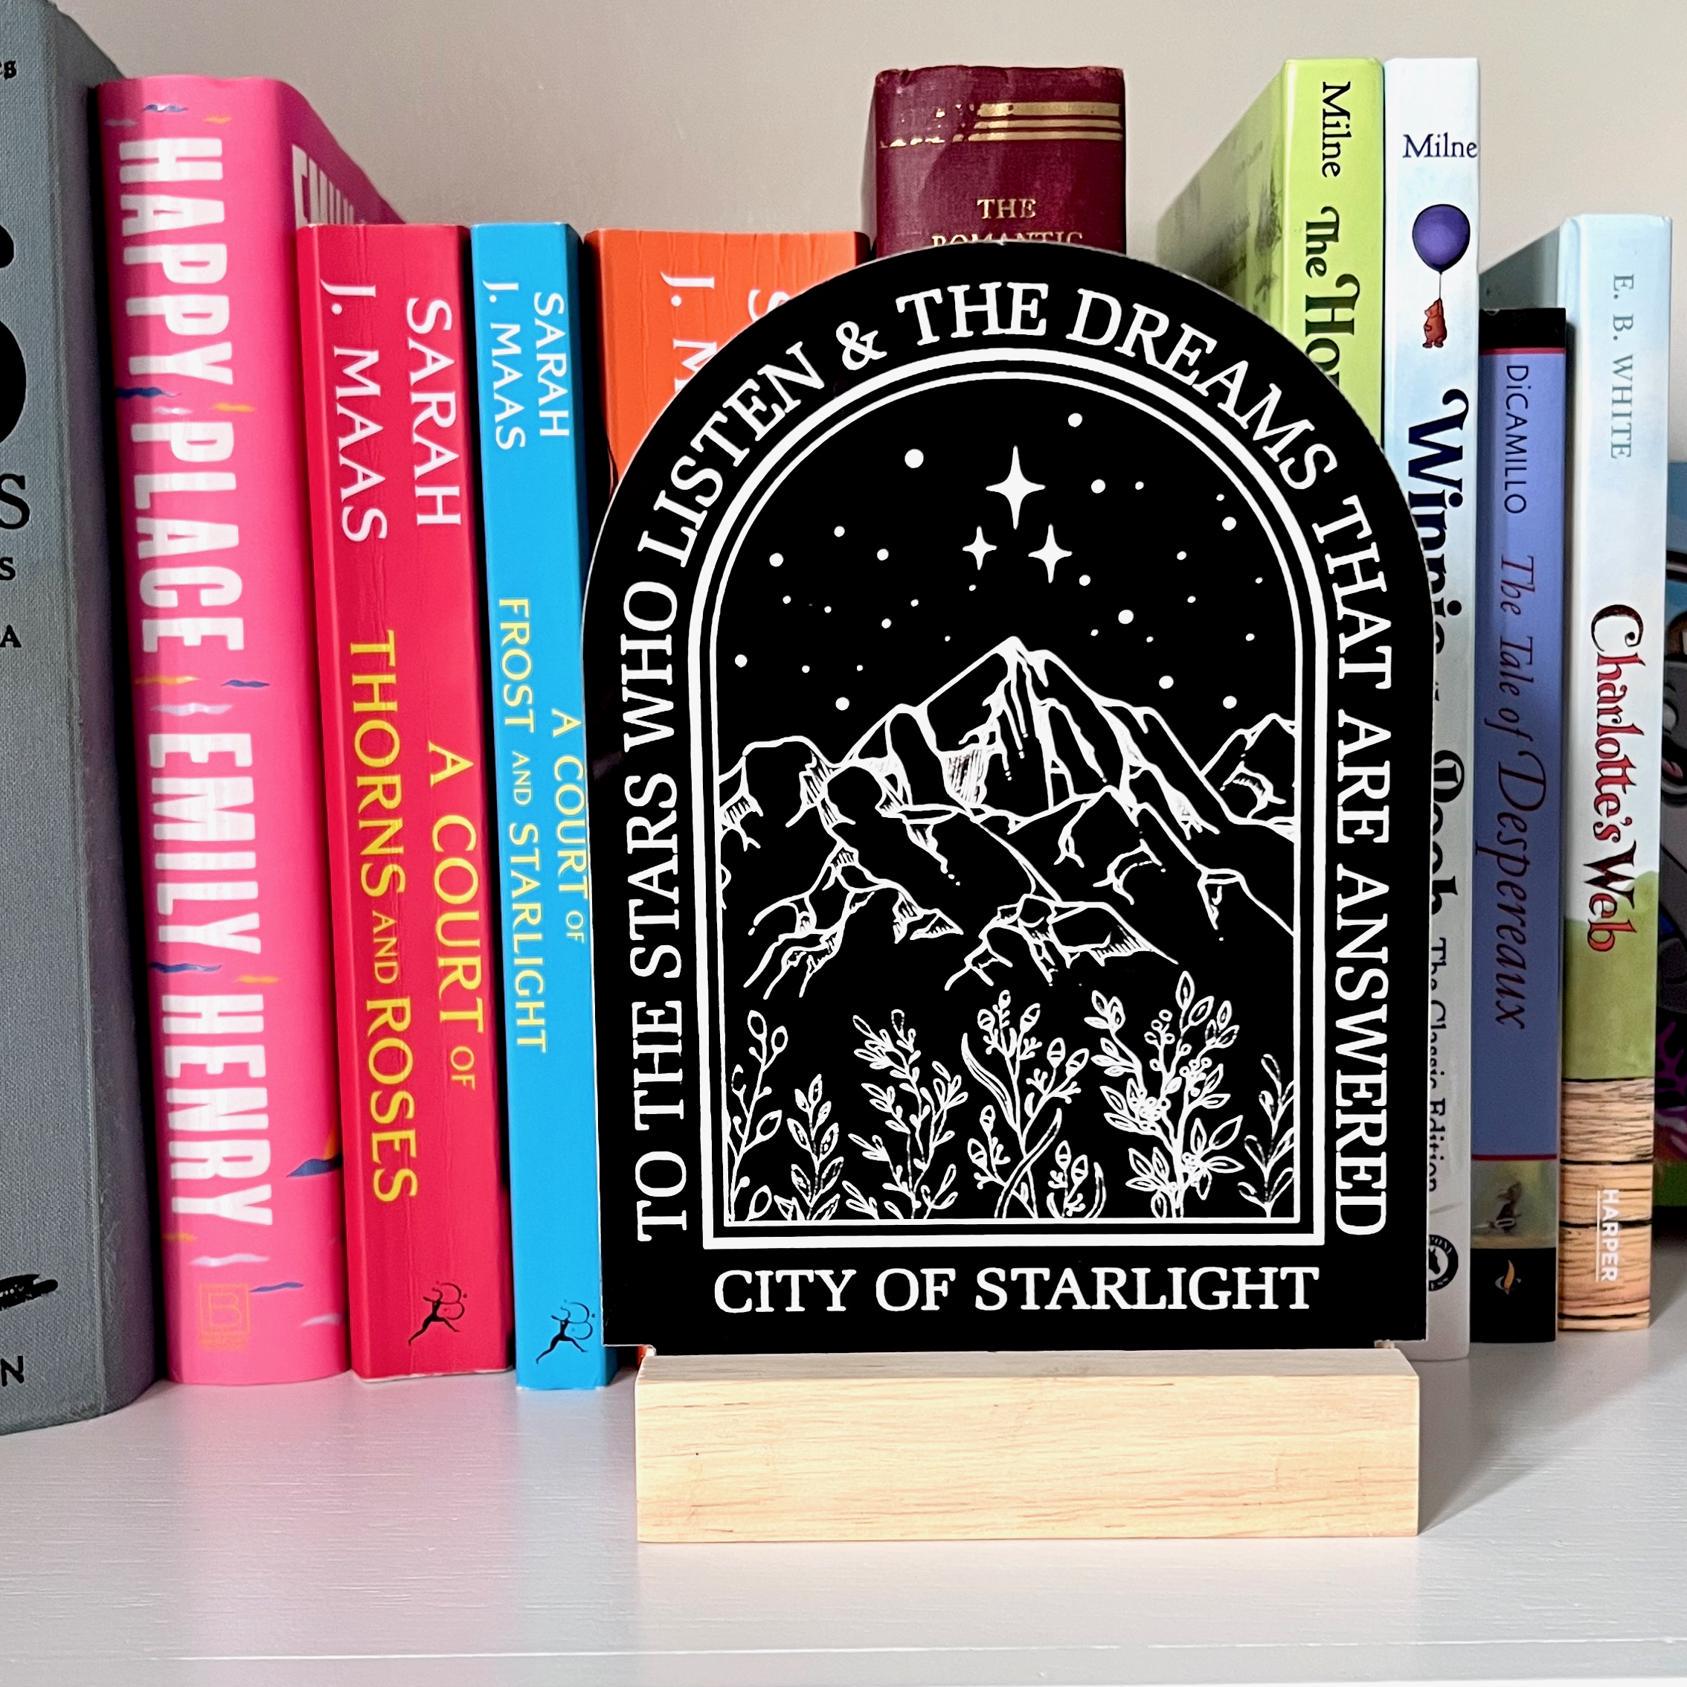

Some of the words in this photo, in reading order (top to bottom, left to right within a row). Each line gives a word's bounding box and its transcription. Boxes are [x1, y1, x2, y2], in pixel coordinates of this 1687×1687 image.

[1321, 80, 1353, 178] Milne
[1402, 132, 1478, 158] Milne
[118, 136, 234, 387] HAPPY
[976, 198, 1037, 220] THE
[1305, 205, 1341, 280] The
[320, 281, 377, 315] J.
[482, 281, 519, 304] J.
[835, 320, 888, 371] &
[895, 281, 1049, 346] THE
[1612, 313, 1634, 341] B.
[1613, 273, 1635, 300] E.
[406, 297, 462, 526] SARAH
[489, 323, 526, 450] MAAS
[533, 291, 570, 437] SARAH
[1065, 288, 1338, 490] DREAMS
[1610, 354, 1633, 460] WHITE
[333, 346, 388, 542] MAAS
[637, 340, 825, 568] LISTEN
[1503, 364, 1530, 515] DiCAMILLO
[130, 420, 245, 653] PLACE
[1311, 494, 1392, 690] THAT
[1500, 555, 1536, 616] The
[499, 598, 535, 734] FROST
[551, 708, 583, 738] A
[620, 581, 677, 754] WHO
[1484, 707, 1534, 742] of
[1498, 636, 1535, 697] Tale
[1590, 603, 1646, 844] Charlotte's
[349, 629, 406, 898] THORNS
[428, 740, 475, 788] A
[512, 752, 533, 807] AND
[553, 755, 590, 899] COURT
[1336, 708, 1392, 844] ARE
[148, 731, 262, 956] EMILY
[624, 772, 682, 979] STARS
[1475, 750, 1547, 1030] Despereaux
[1583, 839, 1638, 953] Web
[371, 910, 399, 985] AND
[431, 813, 484, 1034] COURT
[508, 822, 548, 1054] STARLIGHT
[566, 910, 586, 945] OF
[160, 992, 273, 1227] HENRY
[366, 996, 418, 1203] ROSES
[450, 1045, 476, 1090] OF
[631, 1000, 684, 1131] THE
[1334, 863, 1390, 1236] ANSWERED
[635, 1151, 687, 1242] TO
[1600, 1188, 1621, 1283] HARPER
[714, 1268, 858, 1314] CITY
[875, 1266, 957, 1313] OF
[974, 1265, 1321, 1312] STARLIGHT
